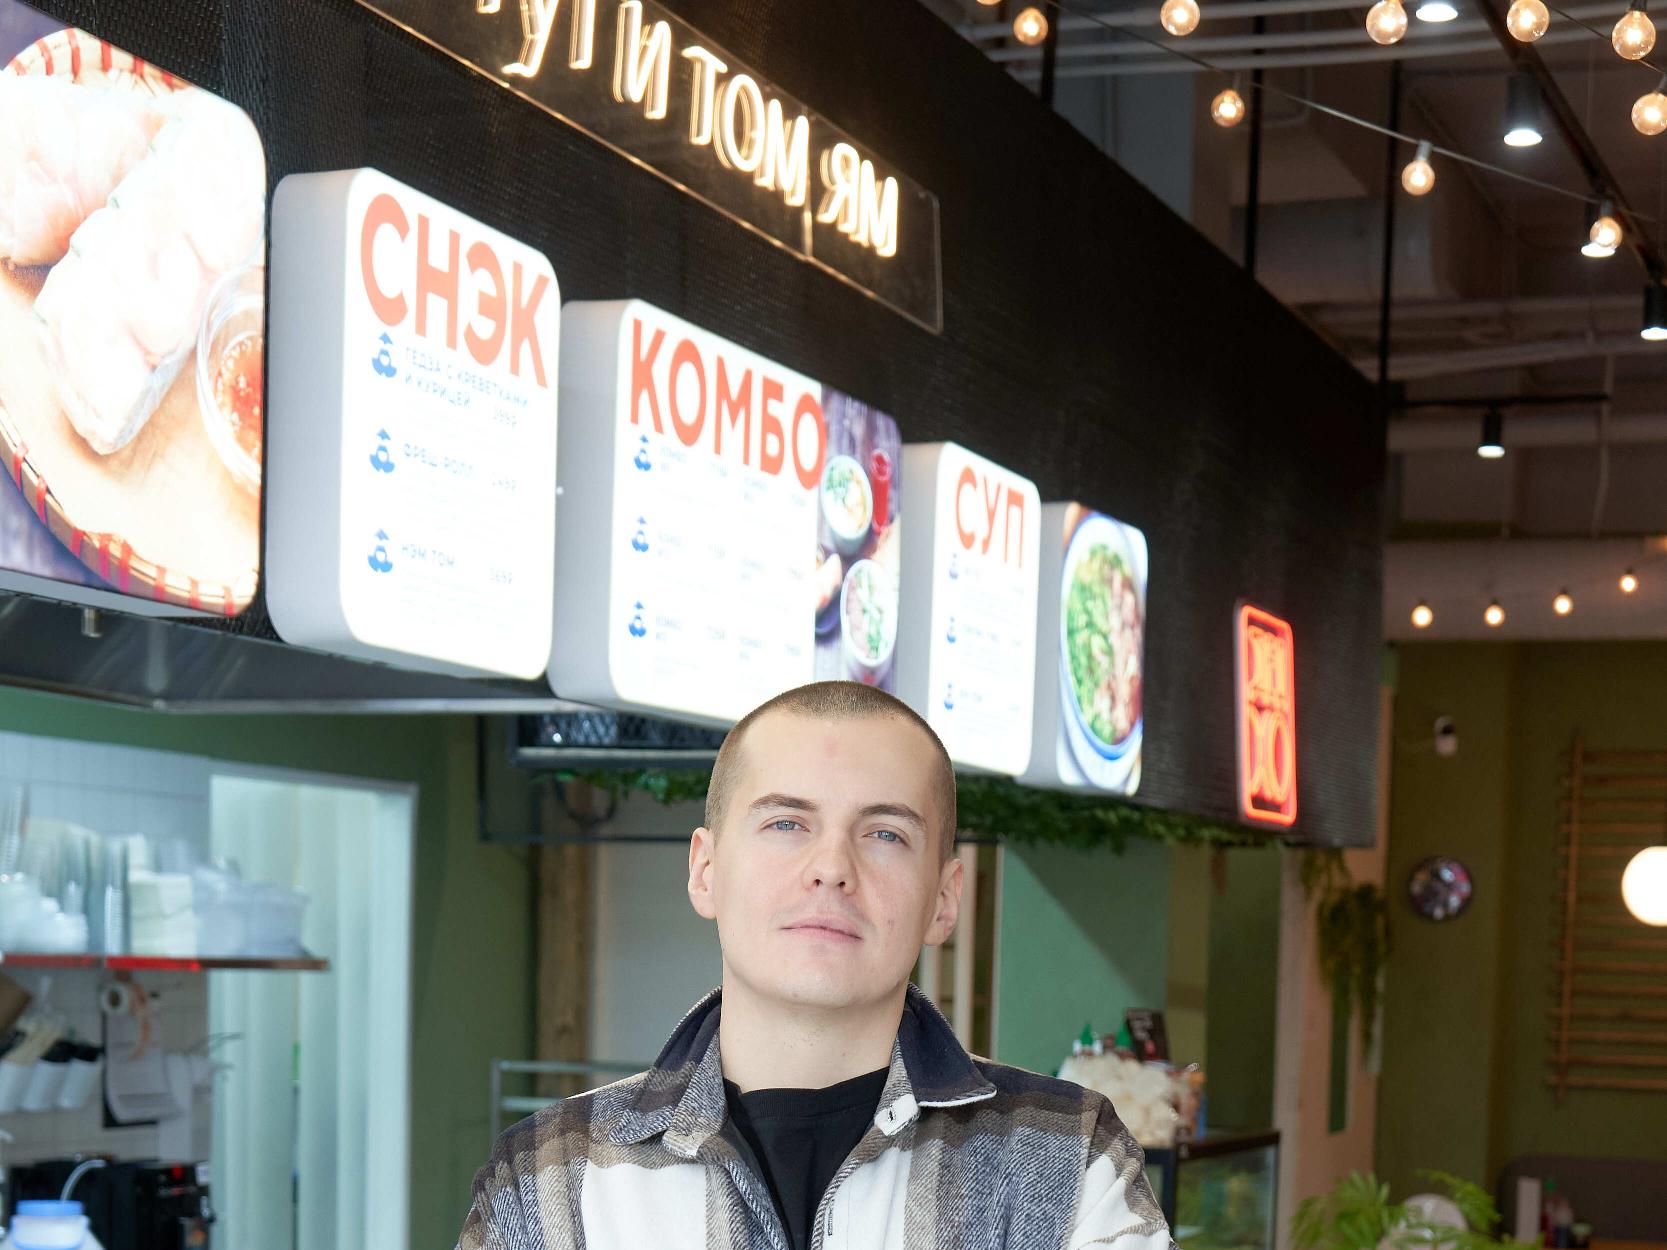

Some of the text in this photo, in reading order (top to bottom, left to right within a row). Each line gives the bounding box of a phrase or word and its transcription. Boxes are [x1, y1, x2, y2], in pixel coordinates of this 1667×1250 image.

[682, 45, 809, 207] ТОМ
[818, 142, 898, 257] ЯМ
[360, 193, 550, 389] СНЭК
[630, 318, 828, 490] КОМБО
[955, 466, 1025, 568] СУП
